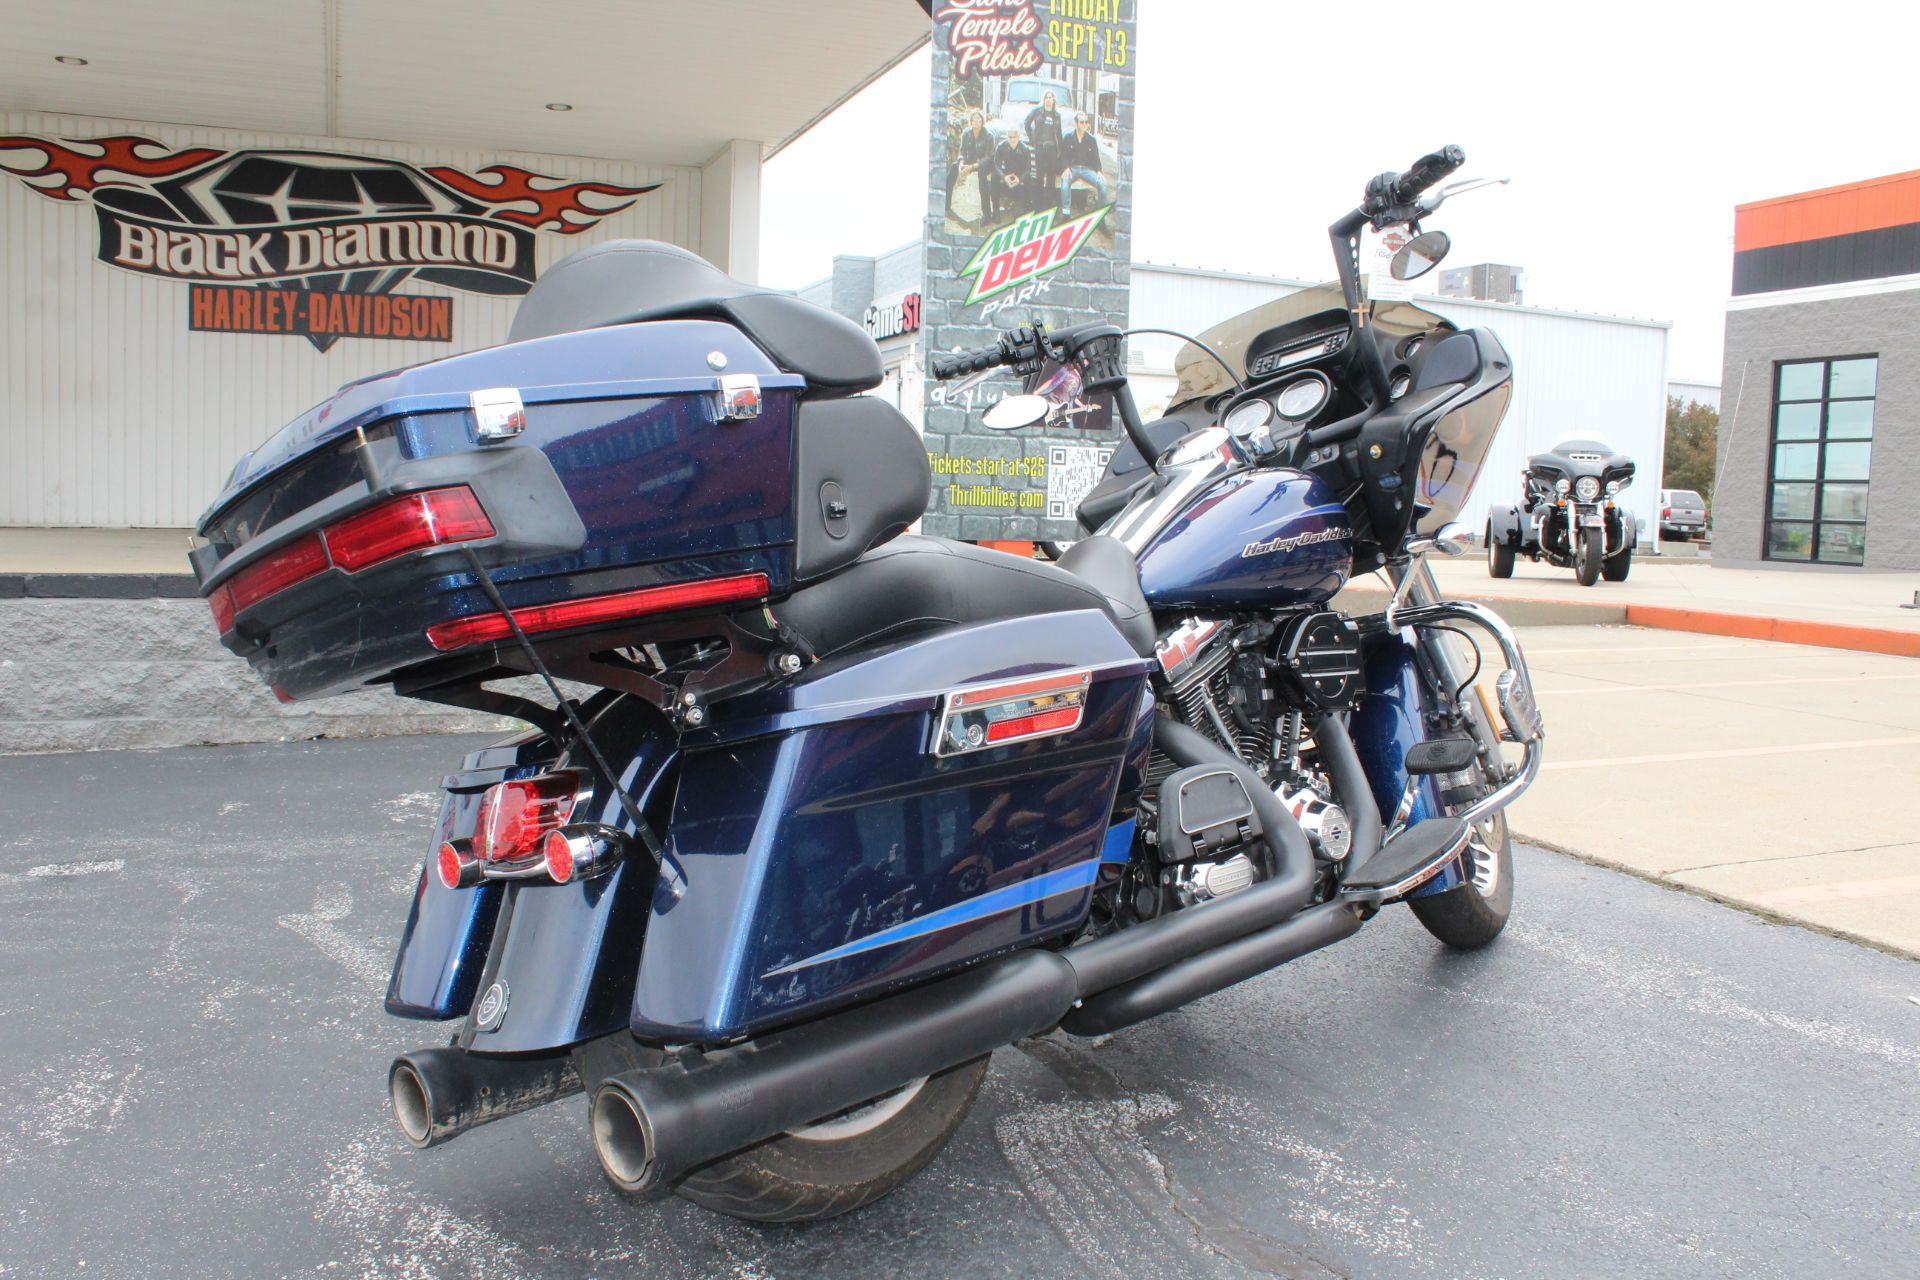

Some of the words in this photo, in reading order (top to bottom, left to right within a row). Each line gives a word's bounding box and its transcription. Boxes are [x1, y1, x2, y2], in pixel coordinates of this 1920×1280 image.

[937, 7, 1037, 46] Temple
[1047, 19, 1097, 62] SEPT
[1104, 28, 1127, 67] 13
[955, 41, 1039, 75] Pilots
[114, 218, 277, 278] Black
[283, 220, 518, 272] Diamond
[193, 286, 450, 339] HARLEY-DAVIDSON
[979, 276, 1055, 321] PARK
[927, 452, 972, 476] Tickets
[975, 456, 1006, 477] start
[1008, 457, 1021, 477] at
[1023, 456, 1045, 478] $25
[949, 483, 1044, 508] Thrillbillies.com
